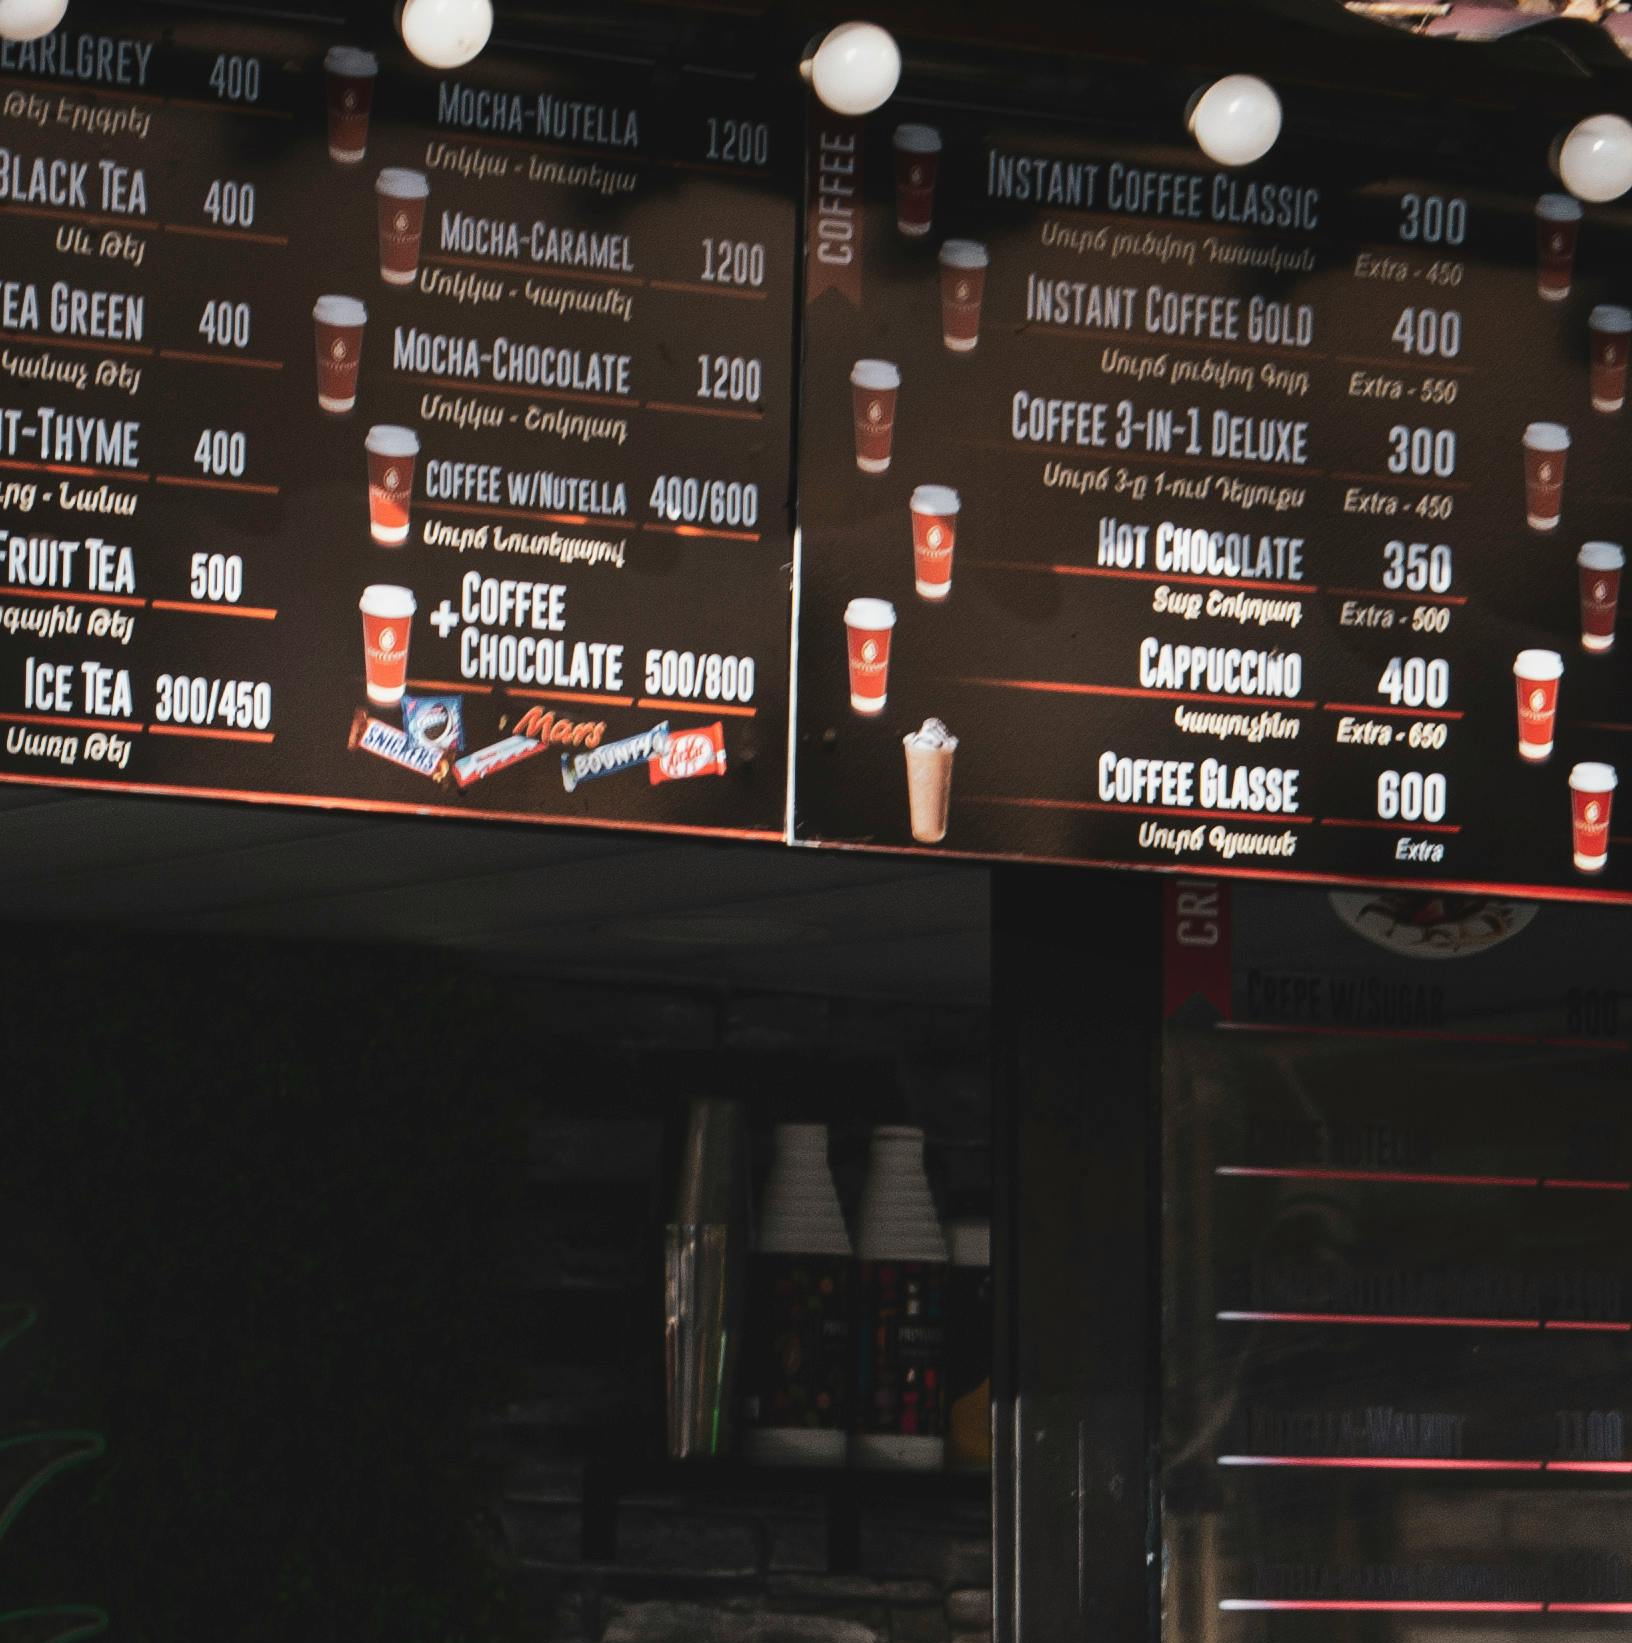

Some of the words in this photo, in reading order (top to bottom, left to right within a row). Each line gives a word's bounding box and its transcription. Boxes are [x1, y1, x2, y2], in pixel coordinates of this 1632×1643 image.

[209, 53, 261, 102] 400
[437, 80, 640, 148] MOCHA-NUTELLA
[705, 115, 769, 166] 1200
[98, 158, 148, 216] TEA
[203, 178, 256, 228] 400
[817, 131, 856, 266] COFFEE
[987, 148, 1101, 208] INSTANT
[1107, 161, 1203, 219] COFFEE
[1210, 172, 1320, 232] CLASSIC
[1398, 191, 1468, 247] 300
[440, 209, 634, 272] MOCHA-CARAMEL
[701, 237, 766, 287] 1200
[50, 281, 145, 342] GREEN
[198, 299, 252, 348] 400
[1026, 271, 1137, 331] INSTANT
[1144, 284, 1240, 342] COFFEE
[1247, 293, 1314, 348] GOLD
[1391, 305, 1462, 358] 400
[393, 325, 632, 394] MOCHA-CHOCOLATE
[697, 354, 762, 403] 1200
[193, 428, 248, 477] 400
[1011, 389, 1108, 448] COFFEE
[1115, 399, 1202, 456] 3-IN-1
[1211, 408, 1310, 466] DELUXE
[1388, 424, 1457, 478] 300
[426, 458, 503, 504] COFFEE
[649, 474, 759, 528] 400/600
[86, 537, 136, 594] TEA
[190, 552, 244, 603] 500
[1097, 516, 1150, 569] HOT
[1154, 521, 1305, 582] CHOCOLATE
[1382, 539, 1453, 594] 350
[461, 570, 567, 632] COFFEE
[1411, 606, 1451, 634] 500
[24, 656, 74, 712] ICE
[81, 660, 133, 718] TEA
[155, 674, 272, 730] 300/450
[460, 626, 625, 691] CHOCOLATE
[644, 648, 756, 702] 500/800
[1139, 637, 1302, 698] CAPPUCCINO
[1377, 656, 1450, 709] 400
[1098, 751, 1194, 806] COFFEE
[1199, 757, 1300, 813] GLASSE
[1376, 769, 1447, 823] 600
[1395, 836, 1444, 863] Extra
